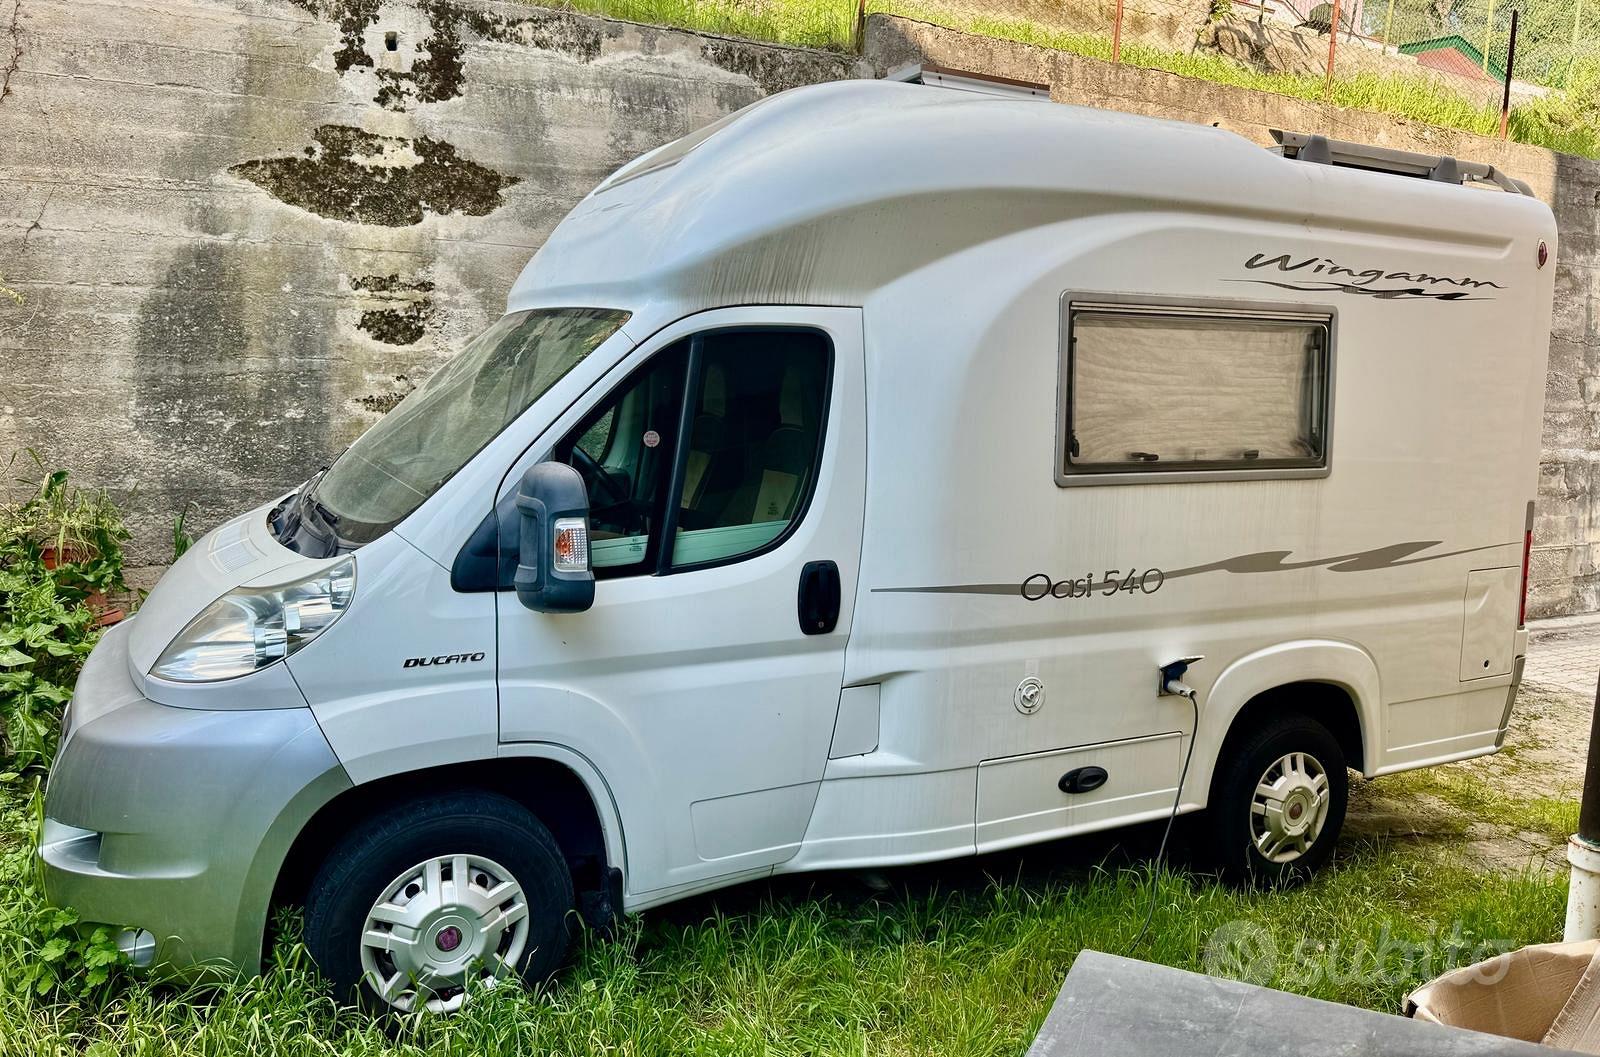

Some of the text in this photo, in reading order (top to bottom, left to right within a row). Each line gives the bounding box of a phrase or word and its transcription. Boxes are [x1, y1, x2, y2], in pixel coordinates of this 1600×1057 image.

[1244, 252, 1508, 289] Wingamm
[1020, 568, 1164, 601] Oasi 540
[403, 652, 485, 668] DUCATO
